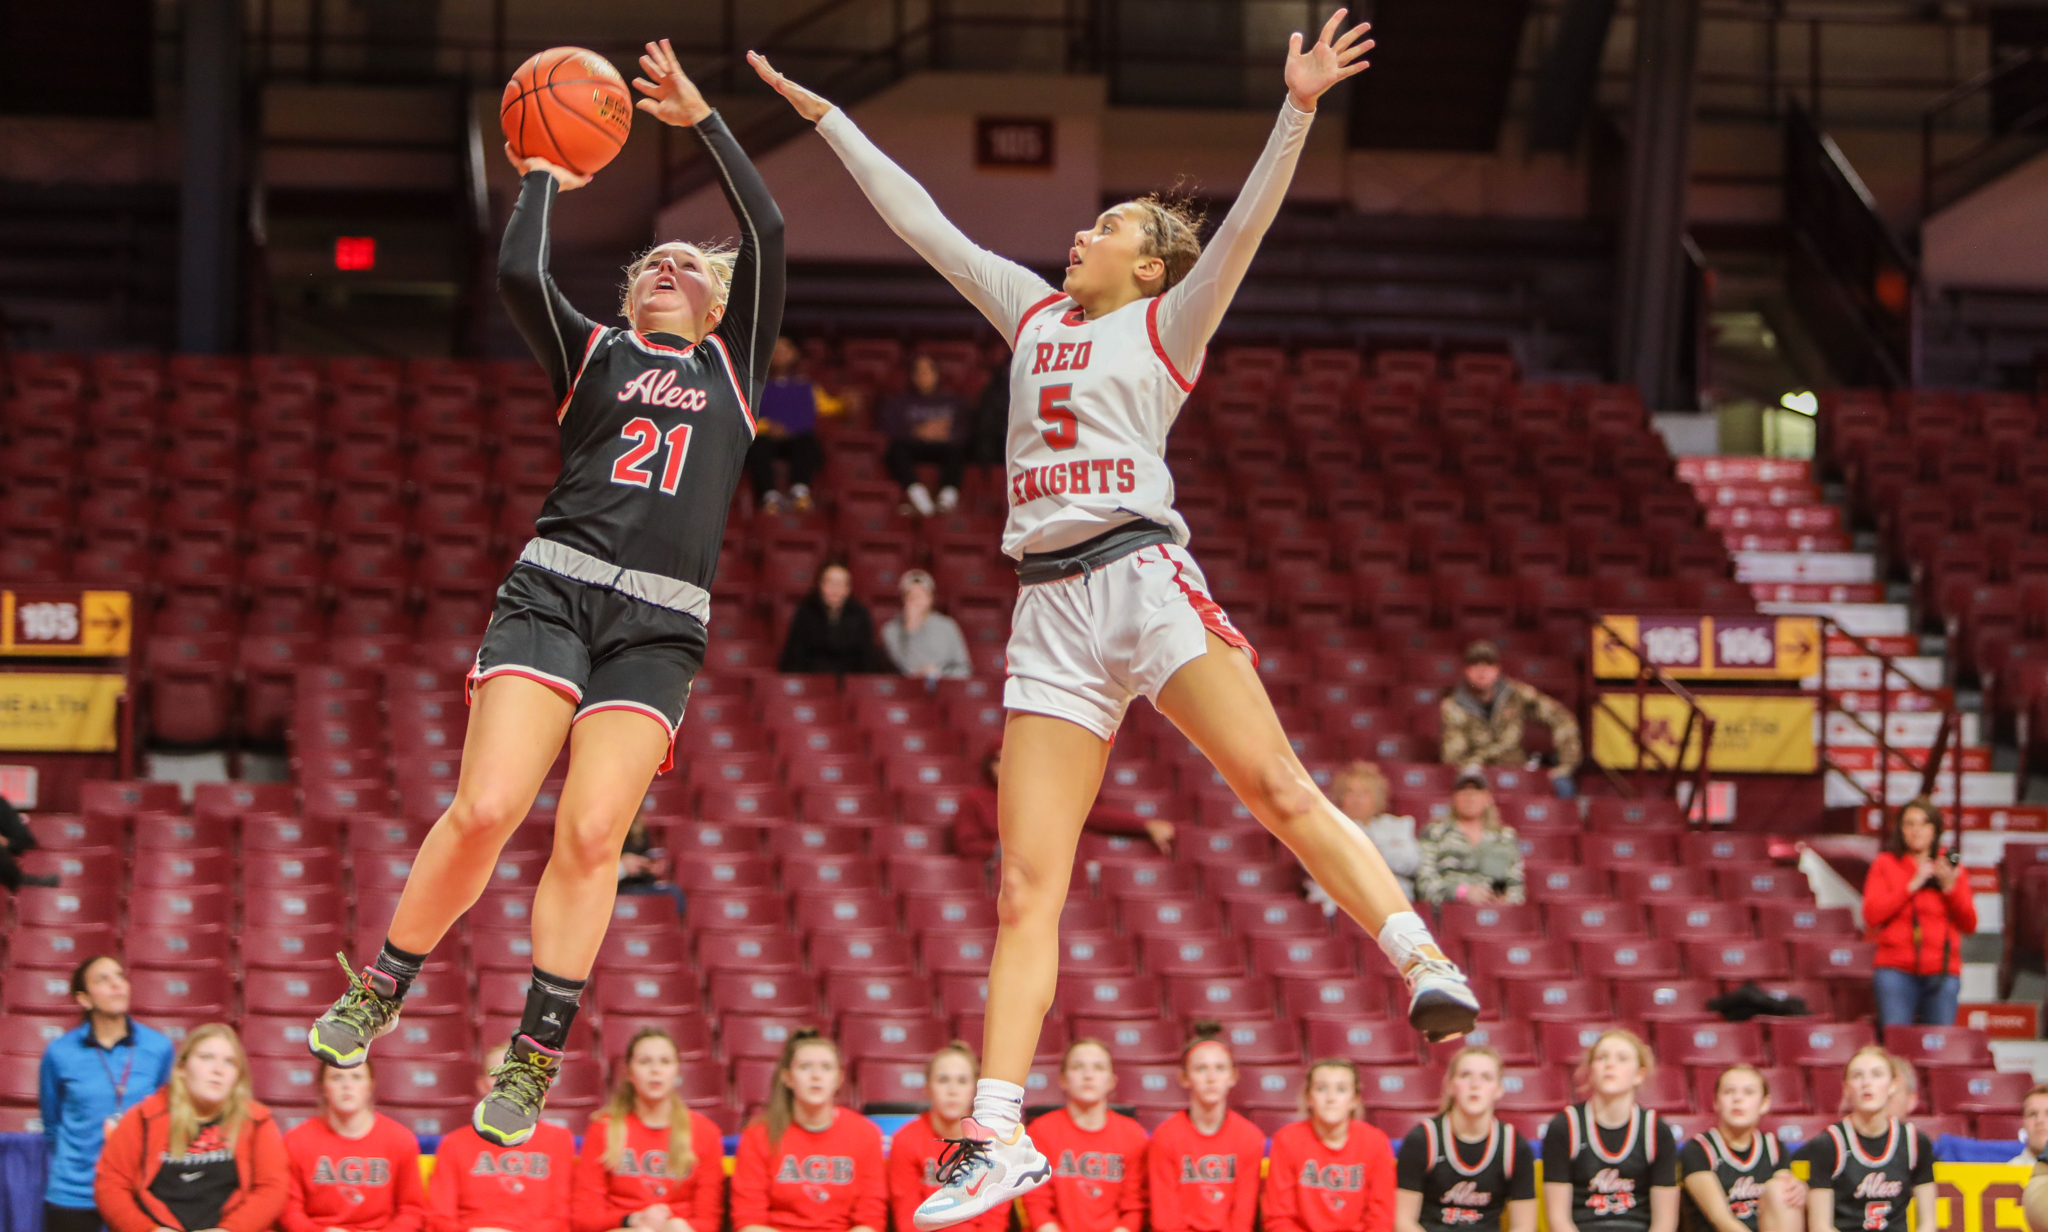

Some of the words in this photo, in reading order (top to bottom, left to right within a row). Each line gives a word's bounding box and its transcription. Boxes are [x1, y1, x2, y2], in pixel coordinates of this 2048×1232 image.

[1032, 341, 1092, 374] RED
[617, 368, 707, 411] Alex
[1038, 383, 1078, 452] 5
[611, 417, 692, 496] 21
[1013, 458, 1135, 506] KNIGHTS
[20, 602, 79, 640] 105
[1643, 626, 1699, 664] 105
[1718, 627, 1771, 664] 106
[313, 1155, 391, 1186] AGB
[470, 1150, 550, 1179] AGB
[776, 1154, 855, 1184] AGB
[1854, 1171, 1903, 1198] Alex
[1863, 1201, 1893, 1231] 5
